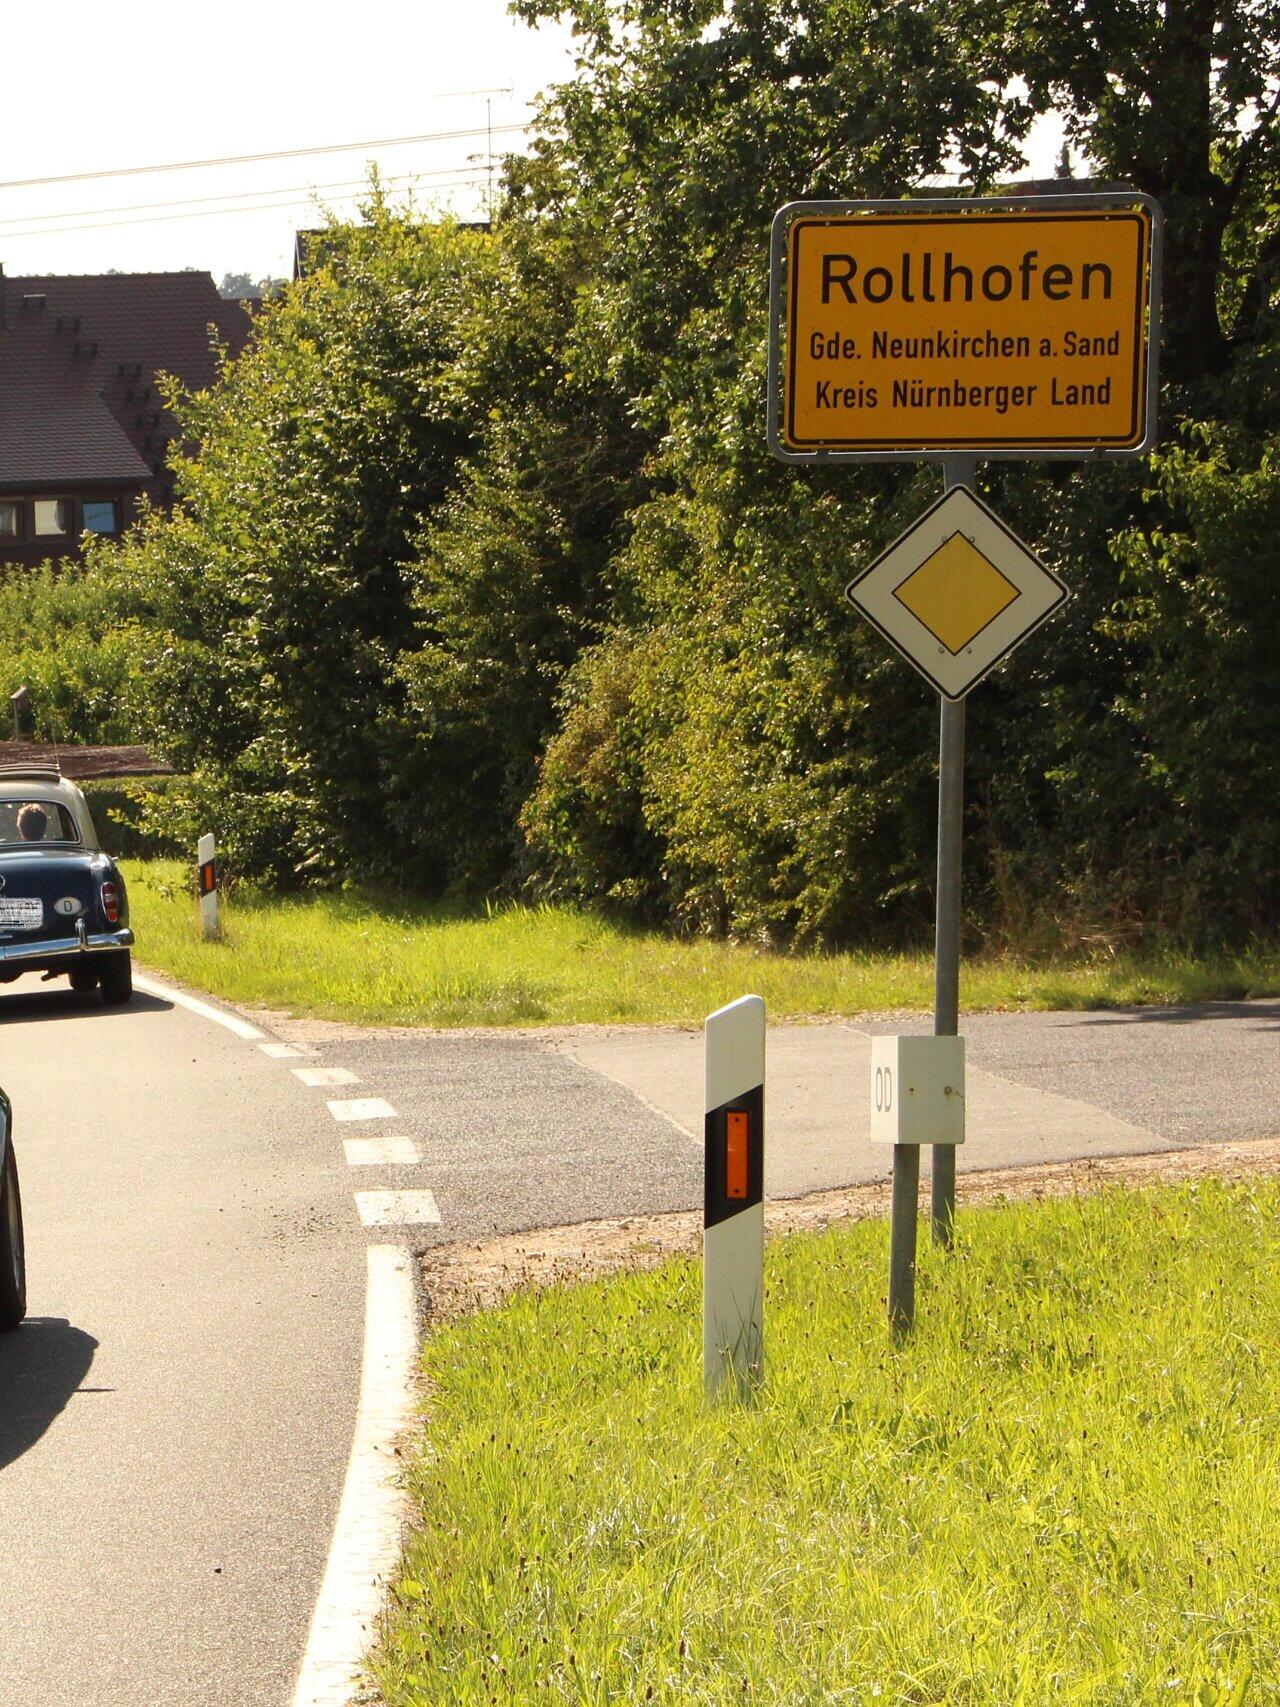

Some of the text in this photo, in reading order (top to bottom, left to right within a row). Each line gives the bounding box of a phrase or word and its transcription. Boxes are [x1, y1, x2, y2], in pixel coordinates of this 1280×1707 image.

[821, 250, 1113, 304] Rollhofen
[810, 329, 1120, 360] Gde. Neunkirchen a. Sand
[815, 376, 1111, 414] Kreis Nürnberger Land
[63, 900, 72, 912] D
[876, 1066, 892, 1113] OD
